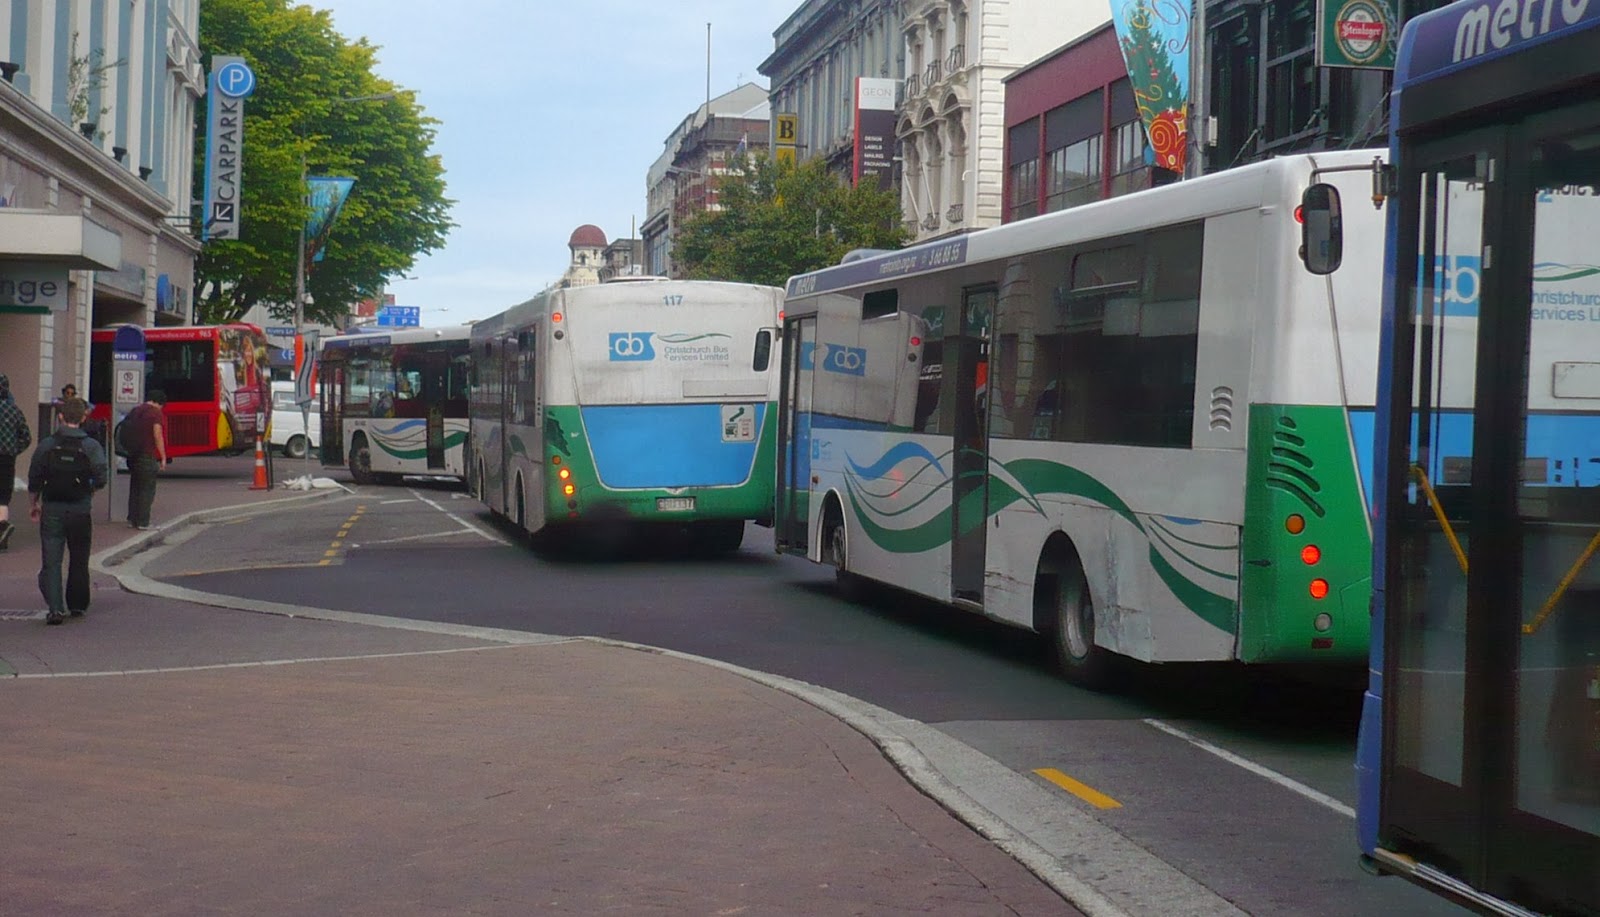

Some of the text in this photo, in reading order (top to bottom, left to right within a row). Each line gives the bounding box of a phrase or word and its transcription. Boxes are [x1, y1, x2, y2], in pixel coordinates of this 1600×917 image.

[229, 68, 245, 91] P
[862, 88, 892, 96] GEON
[217, 101, 239, 201] CARPARK
[663, 295, 683, 306] 117
[664, 345, 729, 354] Christchurch Bus
